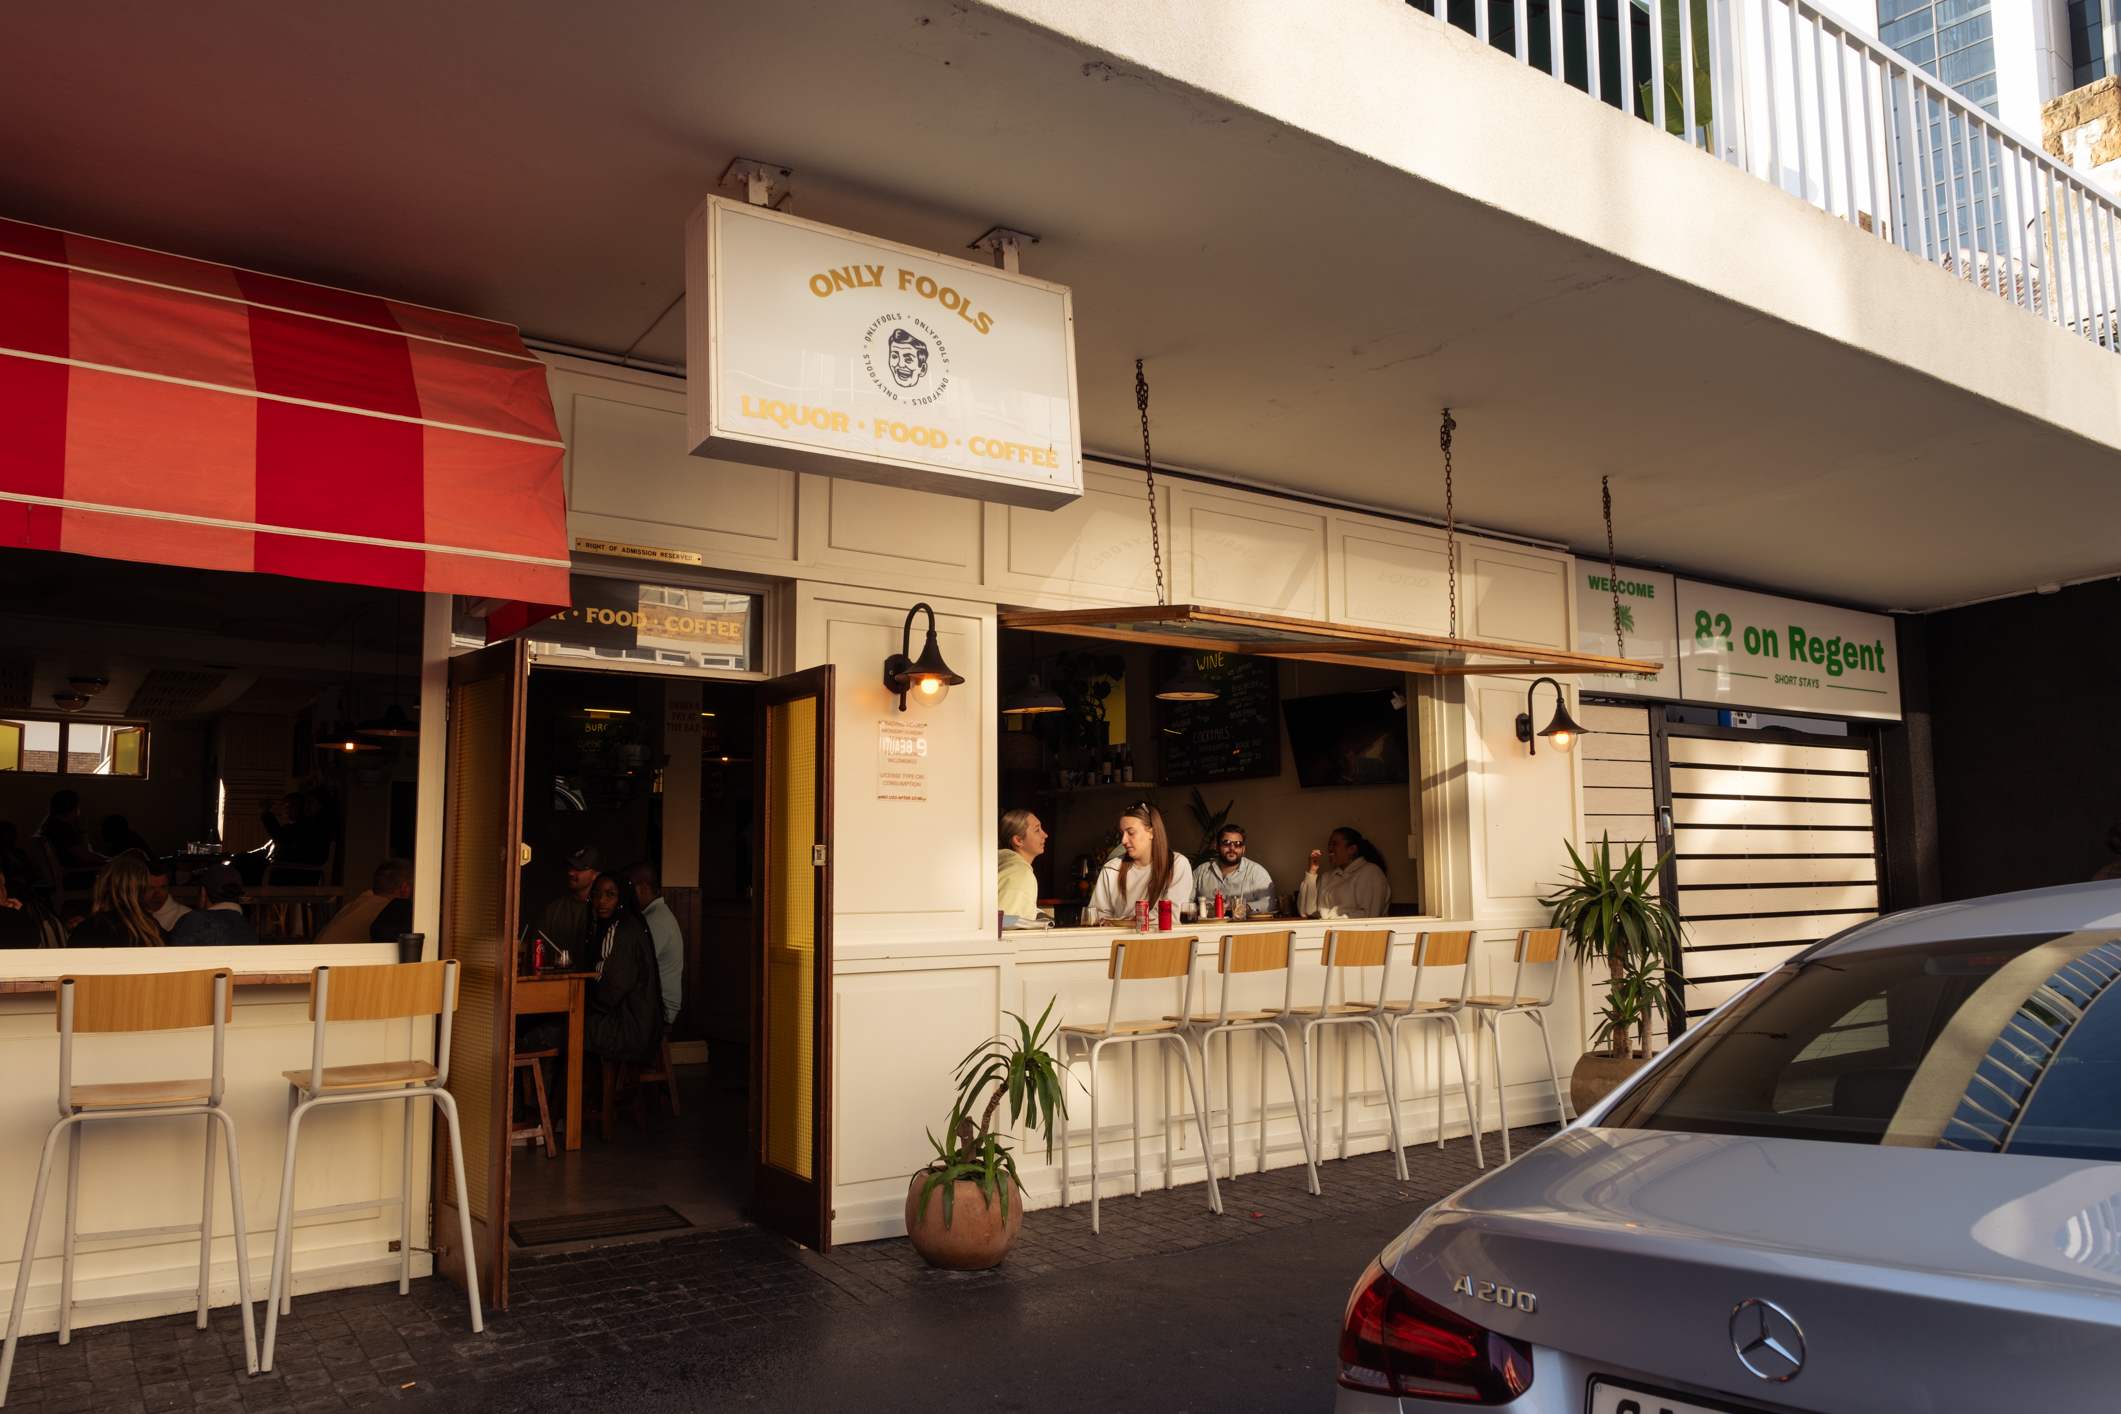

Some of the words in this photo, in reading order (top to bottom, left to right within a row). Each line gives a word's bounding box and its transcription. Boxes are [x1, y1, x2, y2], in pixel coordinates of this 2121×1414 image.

[809, 264, 885, 298] ONLY
[897, 268, 995, 335] FOOLS
[864, 312, 902, 342] ONLYFOOLS
[914, 318, 950, 363] ONLYFOOLS
[862, 354, 898, 401] ONLYFOOLS
[911, 377, 949, 406] ONLYFOOLS
[741, 395, 849, 432] LIQUOR
[874, 418, 948, 449] FOOD
[968, 435, 1060, 469] COFFEE
[585, 542, 605, 551] RIGHT
[621, 546, 657, 557] ADMISSION
[586, 607, 648, 628] FOOD
[663, 616, 742, 638] COFFEE
[1195, 652, 1225, 671] WINE
[1695, 610, 1734, 651] 82
[1743, 626, 1779, 658] on
[1788, 625, 1886, 677] Regent
[1774, 673, 1799, 686] SHORT
[1799, 676, 1820, 688] STAYS
[1453, 1272, 1473, 1297] A
[1478, 1280, 1537, 1313] 200
